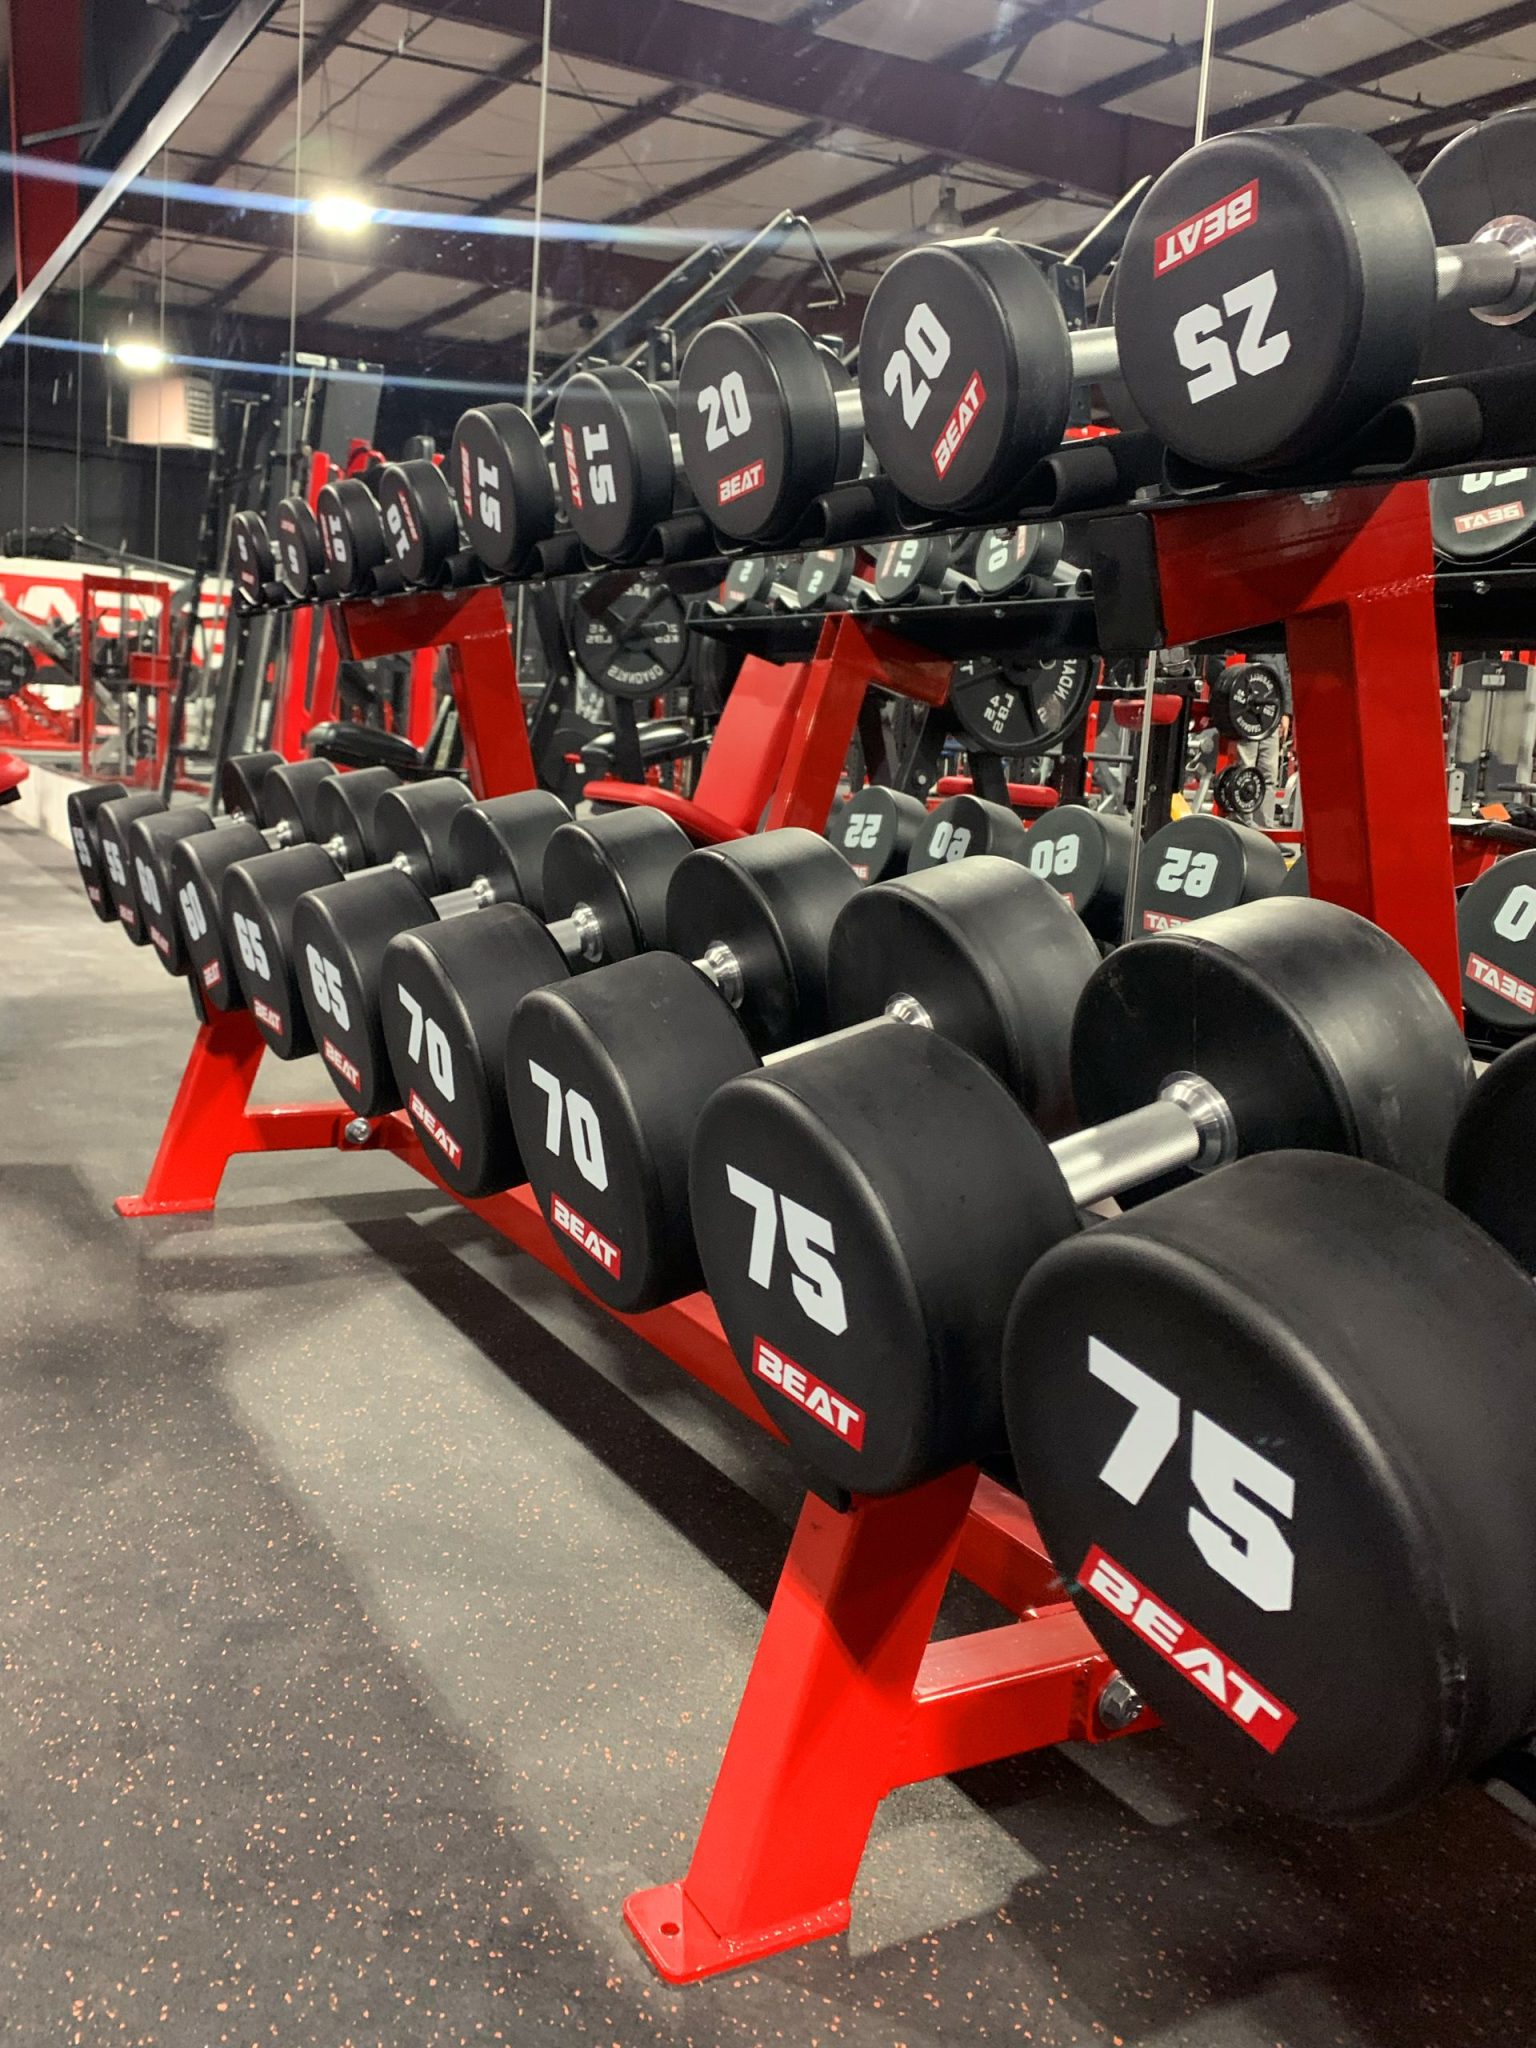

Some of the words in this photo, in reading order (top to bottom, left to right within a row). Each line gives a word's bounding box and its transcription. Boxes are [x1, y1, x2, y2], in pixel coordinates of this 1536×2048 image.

[1159, 190, 1253, 271] BEAT
[884, 303, 950, 430] 20
[1173, 269, 1291, 404] 25
[698, 371, 751, 451] 20
[934, 379, 980, 473] BEAT
[477, 456, 501, 533] 15
[582, 424, 617, 504] 15
[719, 464, 762, 501] BEAT
[179, 881, 207, 941] 60
[233, 912, 271, 981] 65
[306, 943, 350, 1031] 65
[325, 1040, 359, 1085] BEAT
[398, 984, 455, 1102] 70
[411, 1094, 460, 1160] BEAT
[529, 1059, 608, 1192] 70
[555, 1199, 617, 1268] BEAT
[726, 1164, 848, 1336] 75
[759, 1343, 860, 1435] BEAT
[1087, 1336, 1296, 1612] 75
[1090, 1560, 1283, 1724] BEAT
